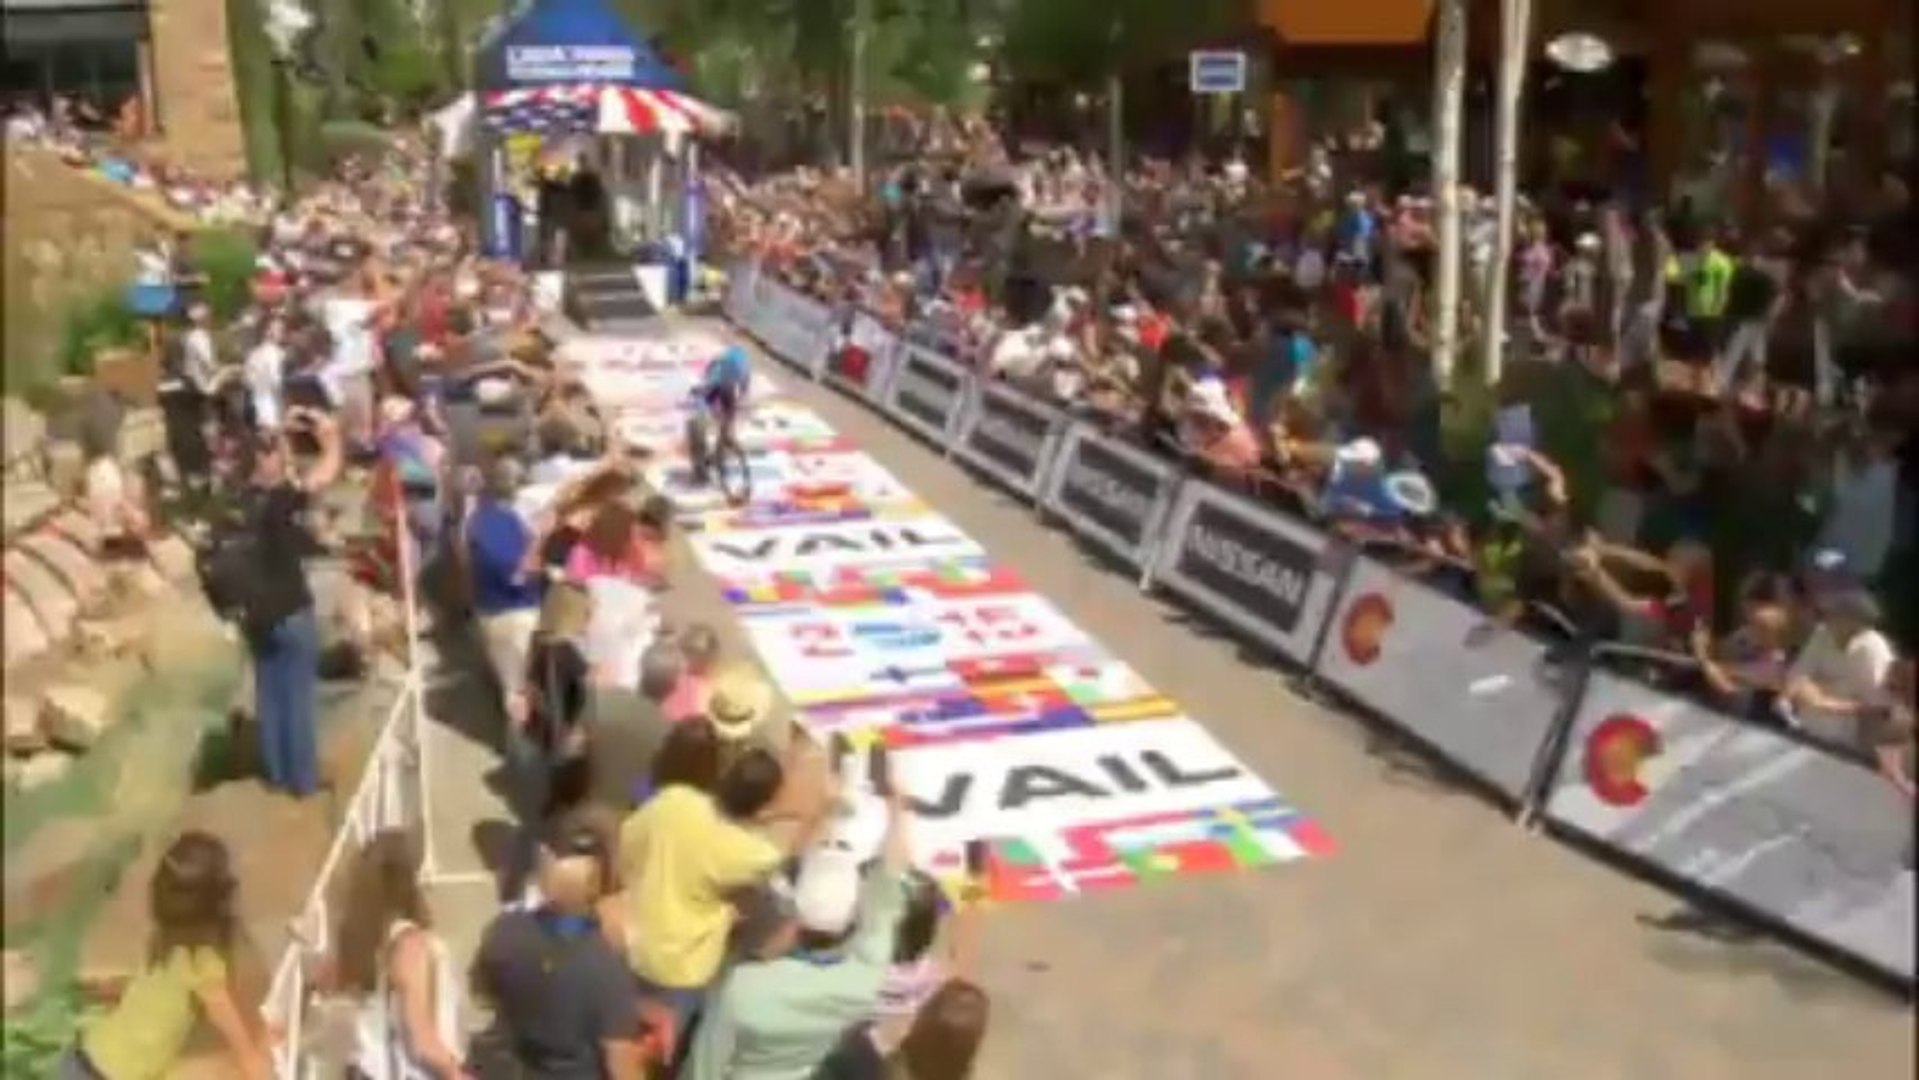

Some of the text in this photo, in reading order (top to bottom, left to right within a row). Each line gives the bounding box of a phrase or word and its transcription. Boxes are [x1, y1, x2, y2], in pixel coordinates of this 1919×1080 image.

[711, 529, 962, 560] VAIL
[1186, 522, 1304, 606] NISSAN
[902, 749, 1242, 819] VAIL
